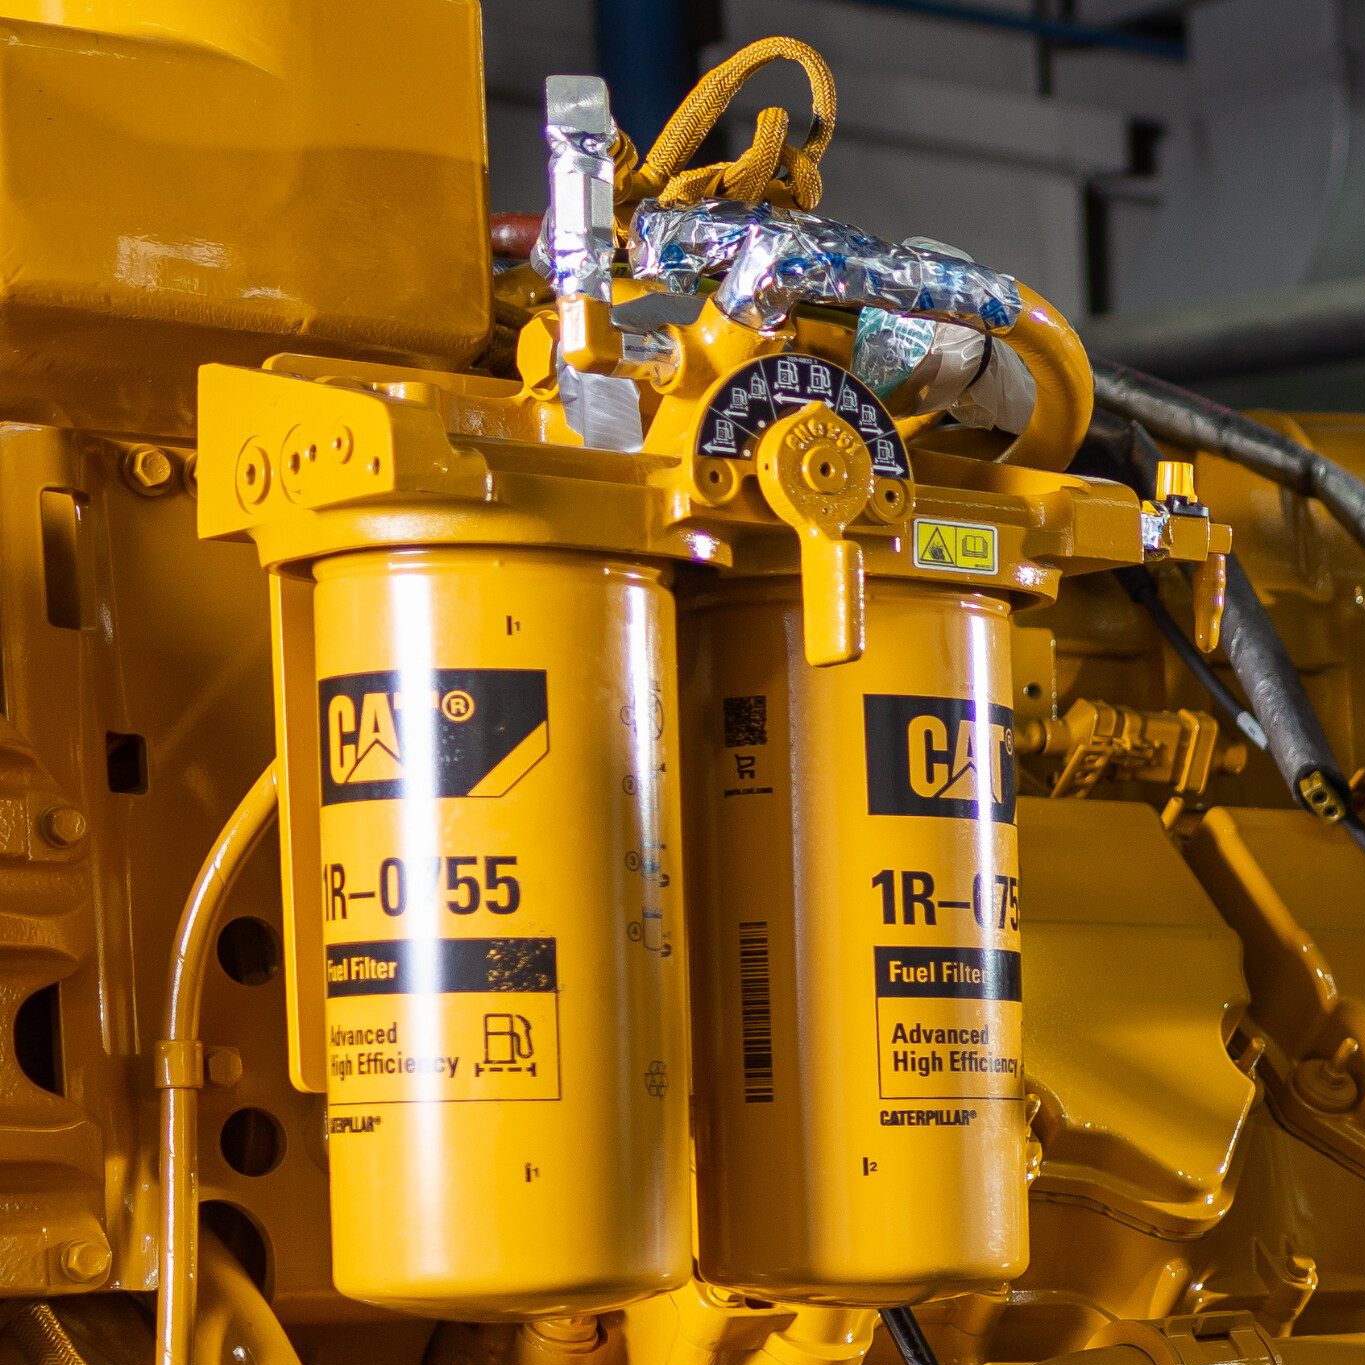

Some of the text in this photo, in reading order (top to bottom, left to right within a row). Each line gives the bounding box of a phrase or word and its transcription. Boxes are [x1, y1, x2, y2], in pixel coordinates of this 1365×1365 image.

[351, 956, 398, 981] Filter
[889, 960, 989, 985] Fuel Filter
[330, 1021, 398, 1047] Advanced
[891, 1022, 989, 1045] Advanced
[893, 1050, 1018, 1079] High Efficiency
